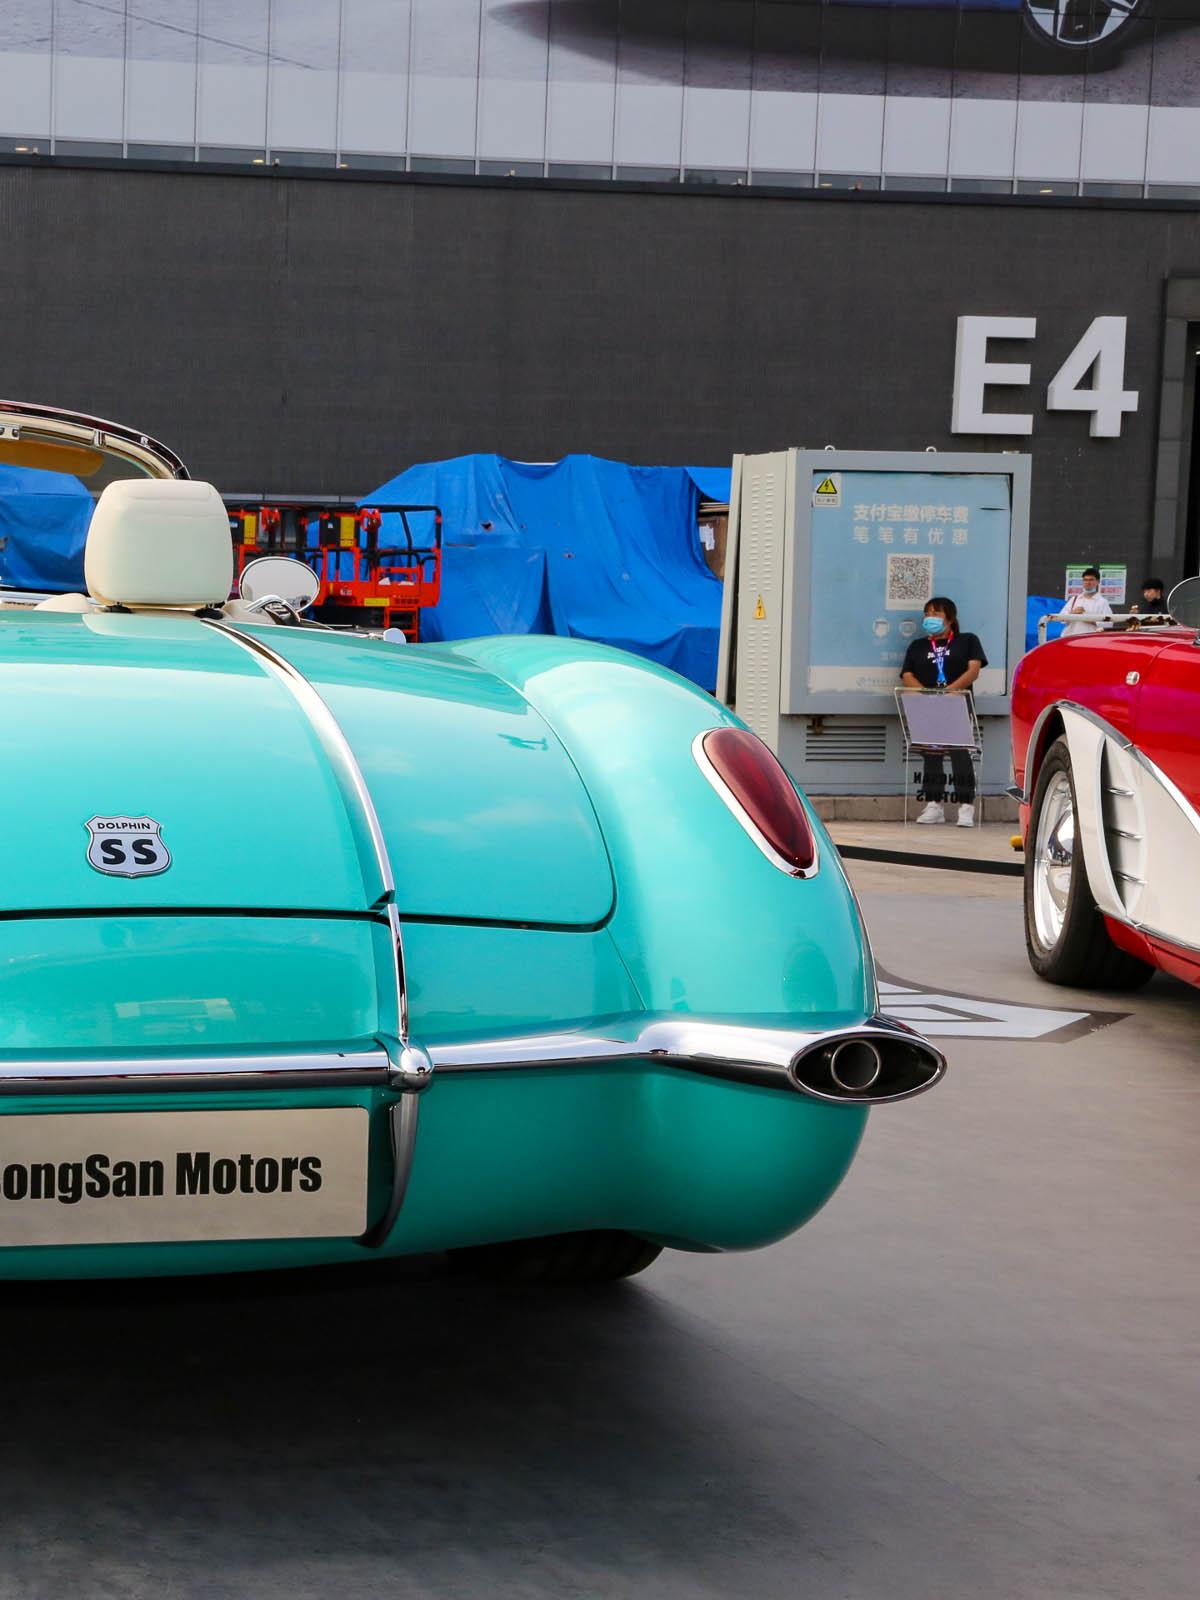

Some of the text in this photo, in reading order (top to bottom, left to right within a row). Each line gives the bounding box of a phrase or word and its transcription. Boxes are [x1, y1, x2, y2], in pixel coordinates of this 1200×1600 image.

[951, 315, 1139, 437] E4
[853, 504, 969, 524] 支付宝缴停车费
[97, 822, 151, 830] DOLPHIN
[100, 839, 158, 865] SS
[175, 1151, 322, 1197] Motors
